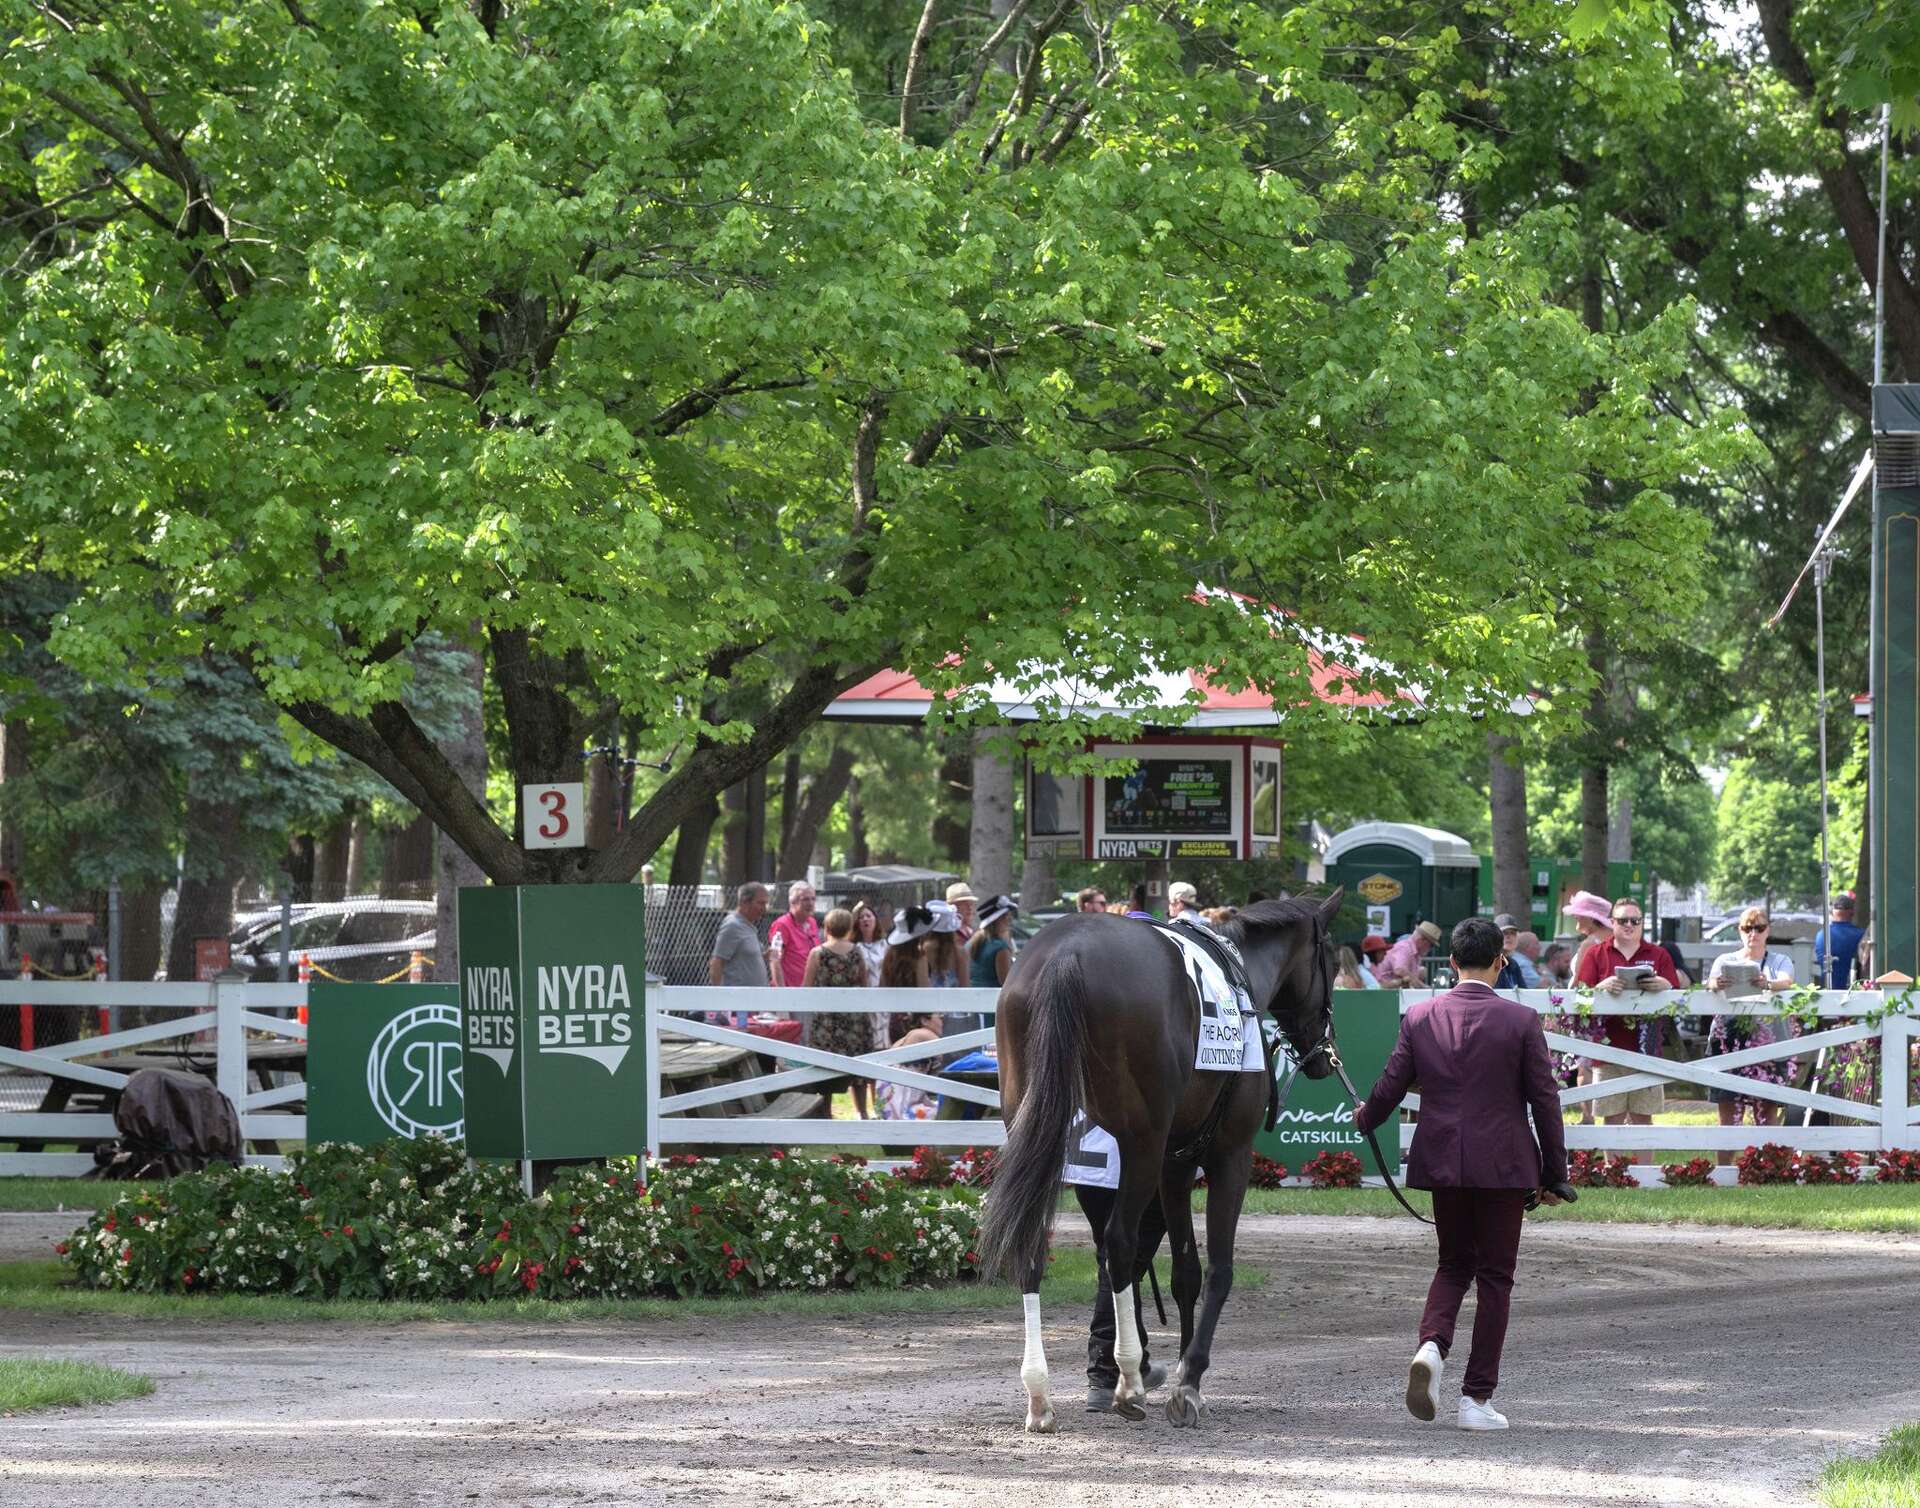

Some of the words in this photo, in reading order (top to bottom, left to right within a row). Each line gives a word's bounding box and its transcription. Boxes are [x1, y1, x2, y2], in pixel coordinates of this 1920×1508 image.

[1170, 771, 1194, 782] FREE
[539, 790, 569, 839] 3
[1101, 840, 1137, 857] NYRA
[1137, 841, 1162, 849] BETS
[1176, 848, 1231, 856] PROMOTIONS
[1181, 841, 1227, 849] EXCLUSIVE
[467, 966, 514, 1013] NYRA
[538, 964, 631, 1010] NYRA
[468, 1015, 515, 1046] BETS
[538, 1012, 632, 1045] BETS
[1202, 1024, 1215, 1040] THE
[1280, 1131, 1364, 1144] CATSKILLS
